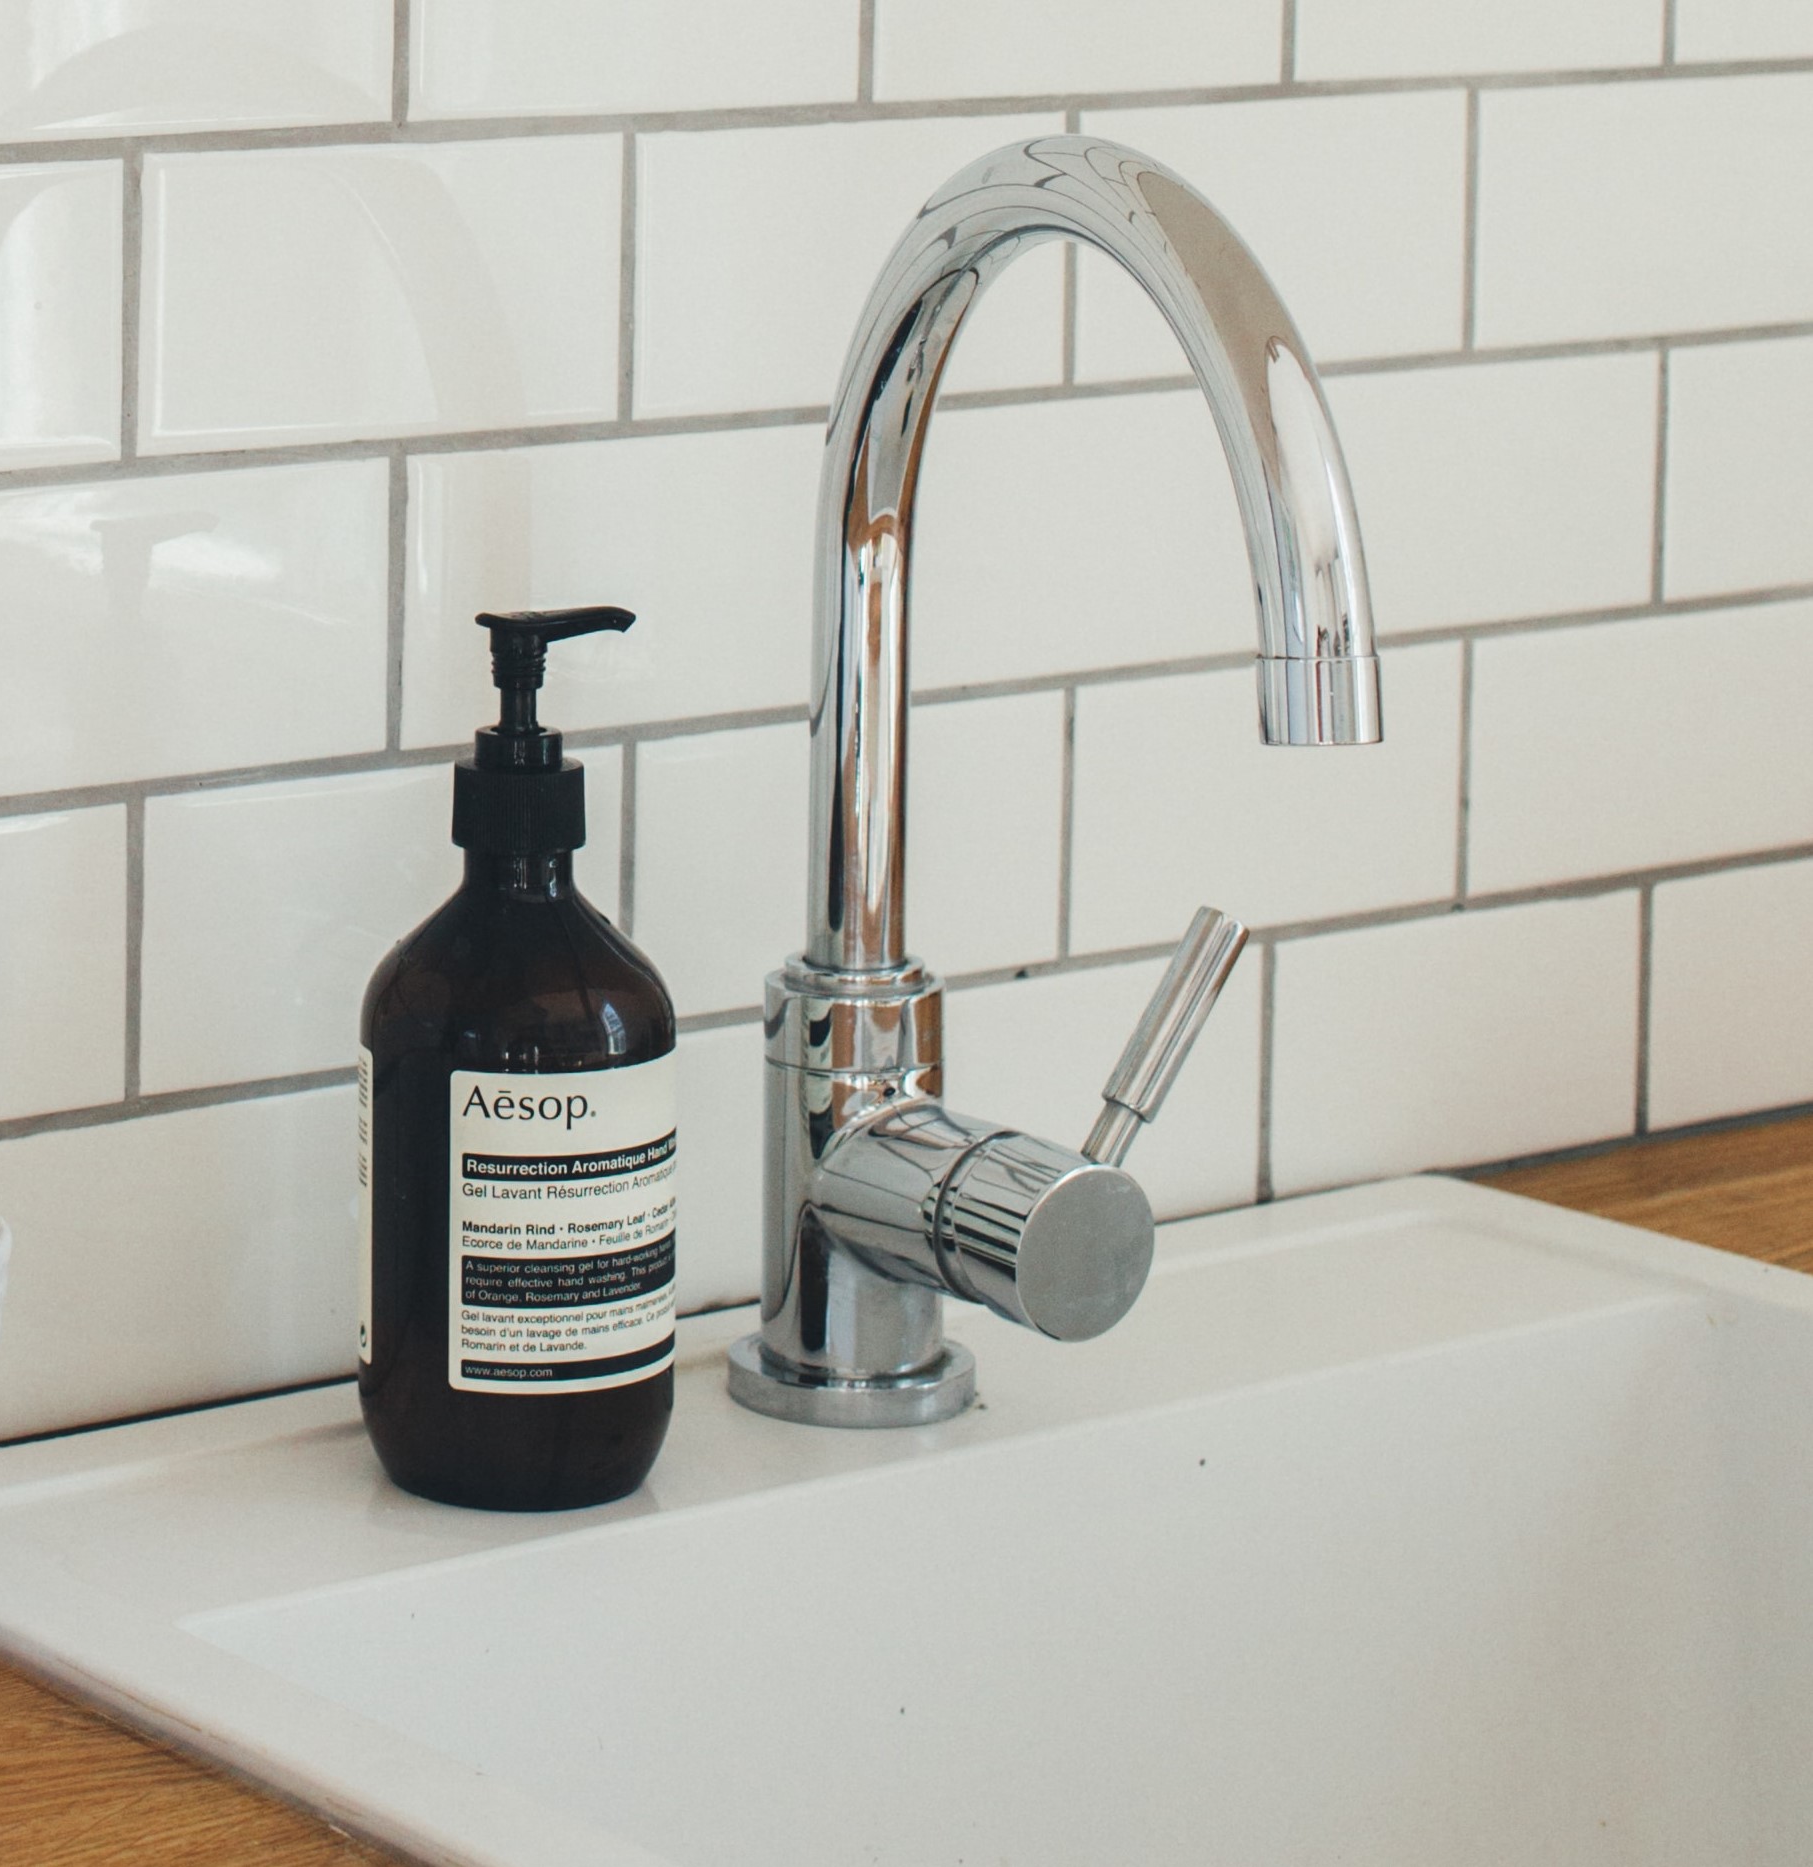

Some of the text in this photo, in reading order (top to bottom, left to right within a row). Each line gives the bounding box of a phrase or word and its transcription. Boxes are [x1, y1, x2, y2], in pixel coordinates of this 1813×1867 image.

[466, 1159, 568, 1175] Resurrection
[571, 1154, 646, 1174] Aromatique
[647, 1140, 668, 1161] Hand
[462, 1183, 487, 1198] Gel
[492, 1186, 542, 1200] Lavant
[547, 1181, 630, 1199] Résurrection
[462, 1221, 522, 1236] Mandarin
[526, 1224, 556, 1236] Rind
[567, 1218, 624, 1234] Rosemary
[627, 1211, 646, 1226] Leaf
[462, 1236, 503, 1250] Ecorce
[507, 1239, 522, 1250] de
[526, 1237, 588, 1250] Mandarine
[599, 1232, 631, 1246] Feuille
[633, 1229, 643, 1240] de
[466, 1260, 474, 1271] A
[476, 1262, 520, 1273] superior
[524, 1262, 575, 1275] cleansing
[578, 1260, 594, 1273] gel
[597, 1259, 609, 1270] for
[466, 1276, 503, 1287] require
[507, 1277, 553, 1288] effective
[557, 1276, 584, 1287] hand
[631, 1265, 646, 1277] This
[465, 1290, 476, 1300] of
[526, 1291, 579, 1302] Rosemary
[582, 1288, 600, 1299] and
[461, 1305, 634, 1326] Gel lavant exceptionnel pour mains
[461, 1325, 496, 1337] besoin
[499, 1327, 523, 1338] d'un
[526, 1328, 562, 1340] lavage
[565, 1327, 578, 1337] de
[581, 1324, 610, 1336] mains
[461, 1339, 587, 1353] Romarin et de Lavande.
[464, 1365, 553, 1379] www.aesop.com
